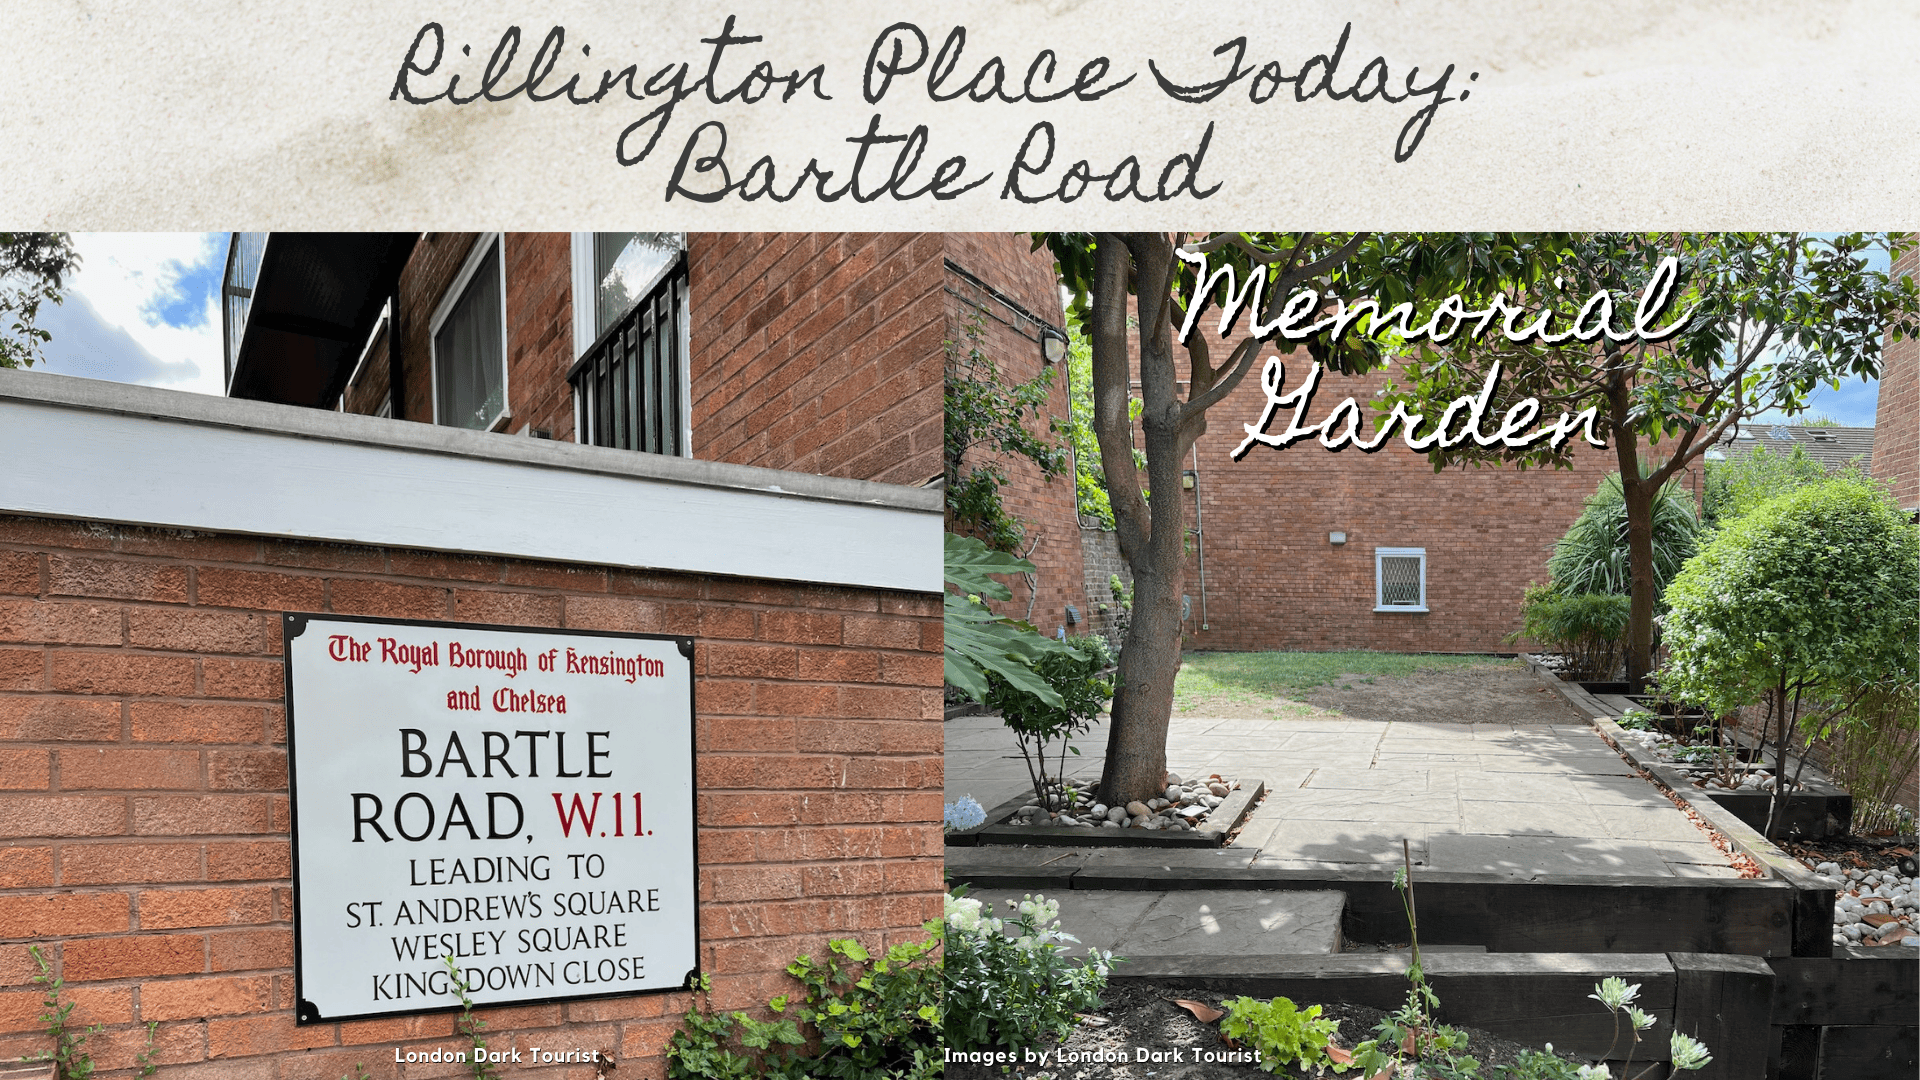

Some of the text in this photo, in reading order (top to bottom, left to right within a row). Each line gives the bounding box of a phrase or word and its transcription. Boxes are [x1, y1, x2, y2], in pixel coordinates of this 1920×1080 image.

[327, 634, 665, 684] The Royal Borough of Kensington
[446, 685, 568, 715] and Chelsea
[398, 728, 614, 779] BARTLE
[350, 791, 654, 845] ROAD, W.11.
[409, 853, 606, 887] LEADING TO
[345, 888, 661, 929] ST. ANDREW'S SQUARE
[391, 922, 628, 962] WESLEY SQUARE
[562, 956, 646, 985] CLOSE
